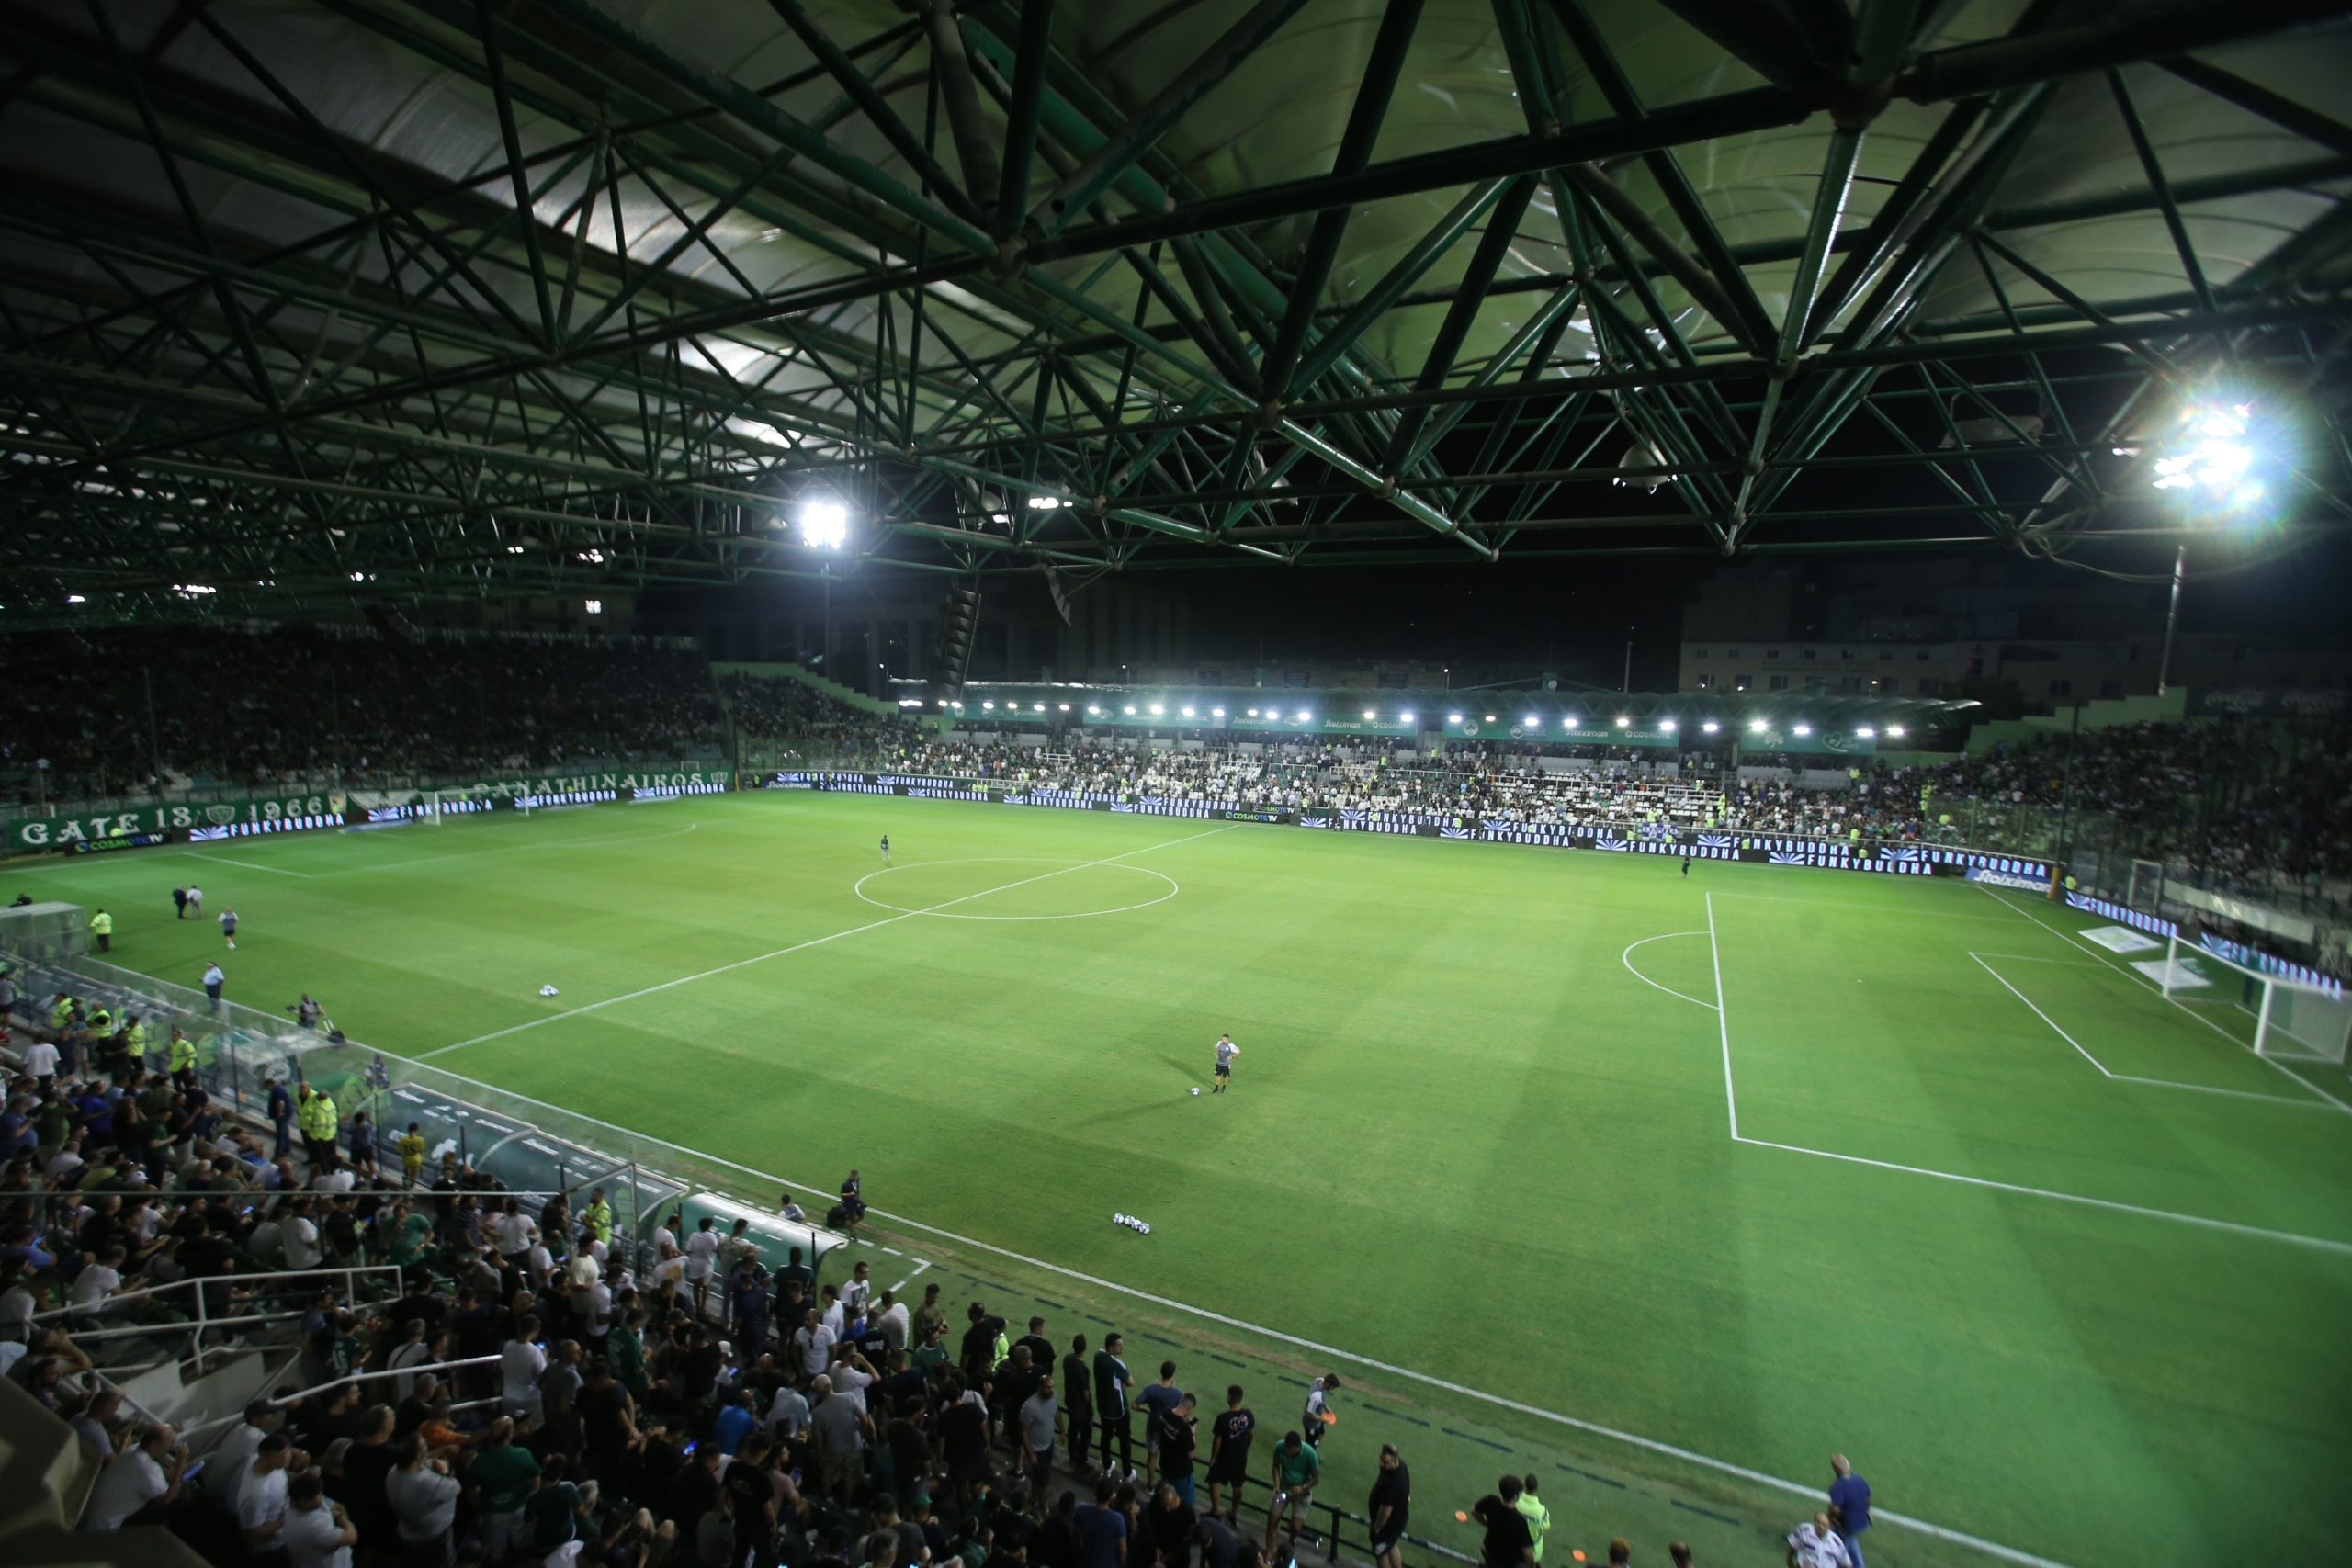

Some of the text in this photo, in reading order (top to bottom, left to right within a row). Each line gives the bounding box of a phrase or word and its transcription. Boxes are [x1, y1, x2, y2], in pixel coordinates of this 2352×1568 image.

[1134, 803, 1210, 818] FUNKYBUDDHA
[1163, 796, 1240, 811] FUNKYBUDDHA
[21, 813, 141, 844] GATE
[248, 795, 322, 821] 1966
[231, 812, 345, 838] FUNKYBUDDHA
[1328, 818, 1416, 835] FNKYBUDDHA
[1629, 840, 1740, 861] FUNKYBUDDHA
[1733, 836, 1849, 857] FNKYBUDDHA
[1921, 849, 2046, 878] FUNKYBUDDHA
